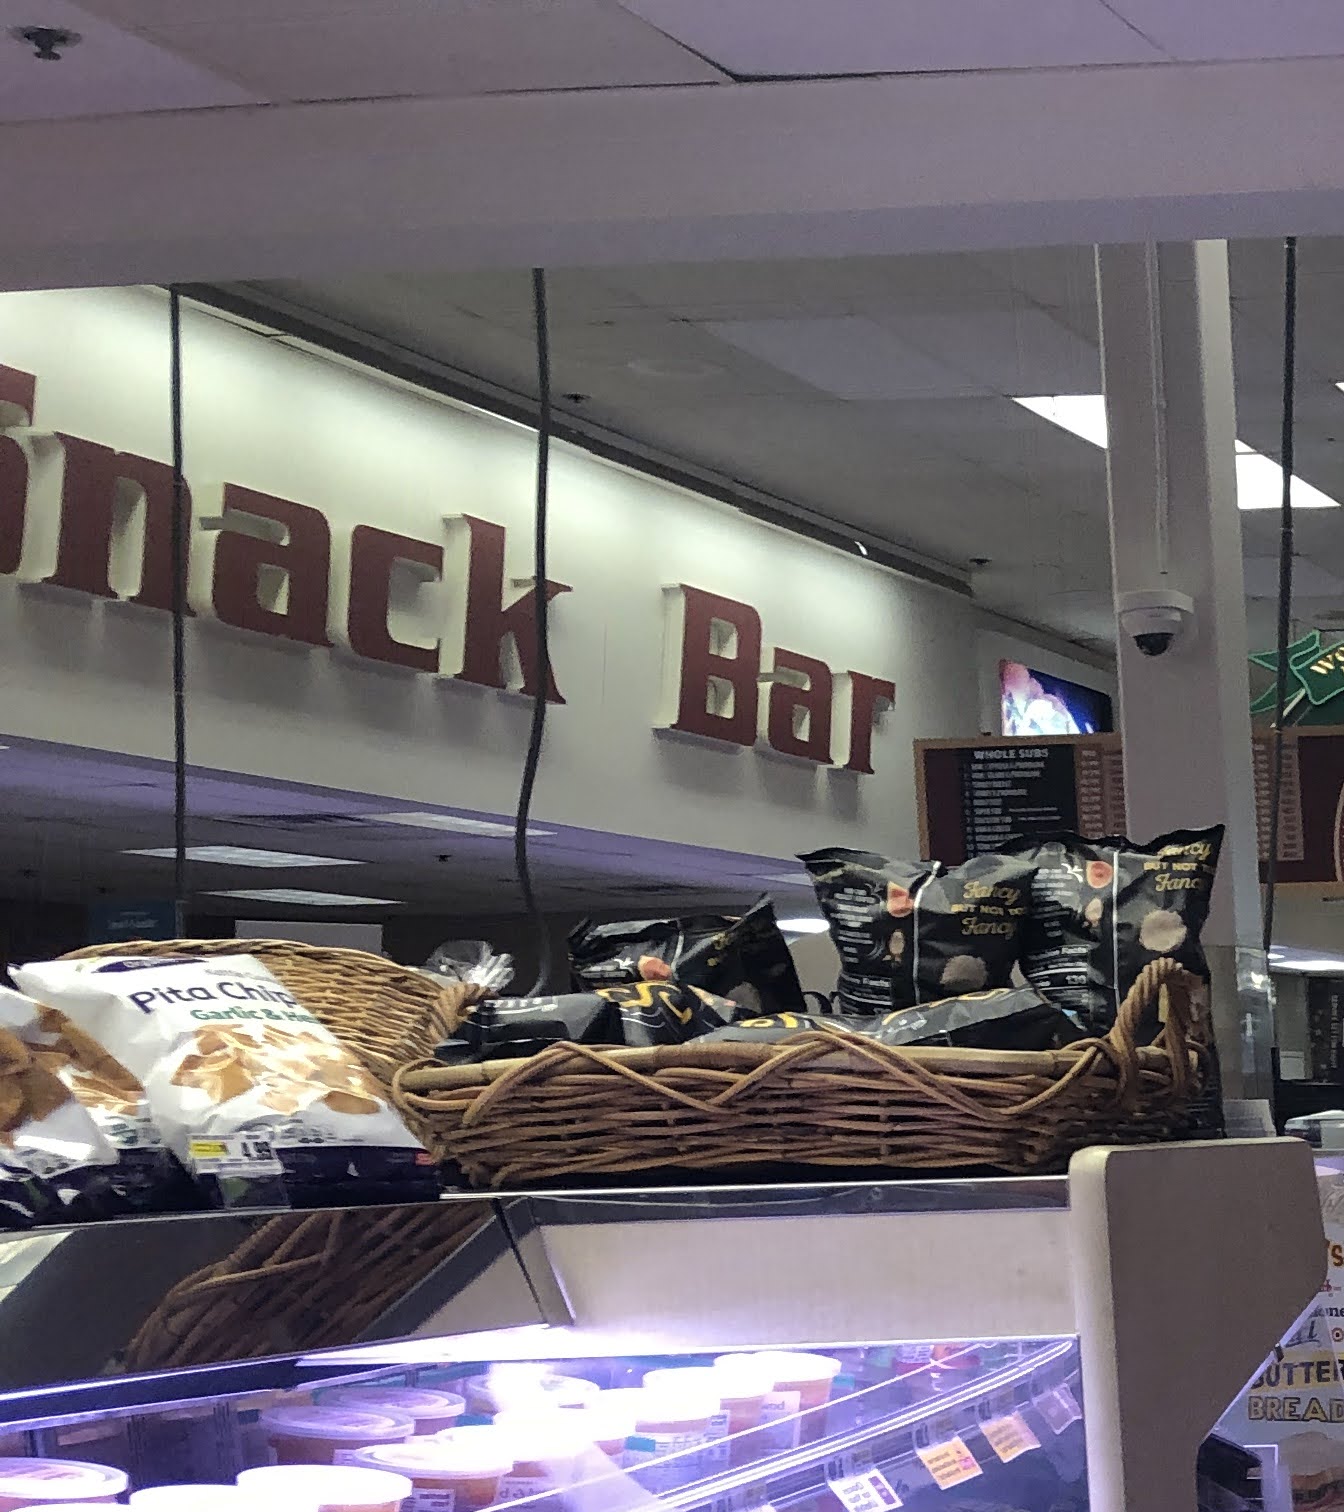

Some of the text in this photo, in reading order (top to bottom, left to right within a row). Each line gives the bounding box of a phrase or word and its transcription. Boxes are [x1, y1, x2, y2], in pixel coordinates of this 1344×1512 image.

[672, 583, 896, 775] Bar
[1154, 873, 1202, 893] Fanc
[130, 980, 302, 1015] Pita Chip
[190, 1007, 319, 1025] Garlic & He
